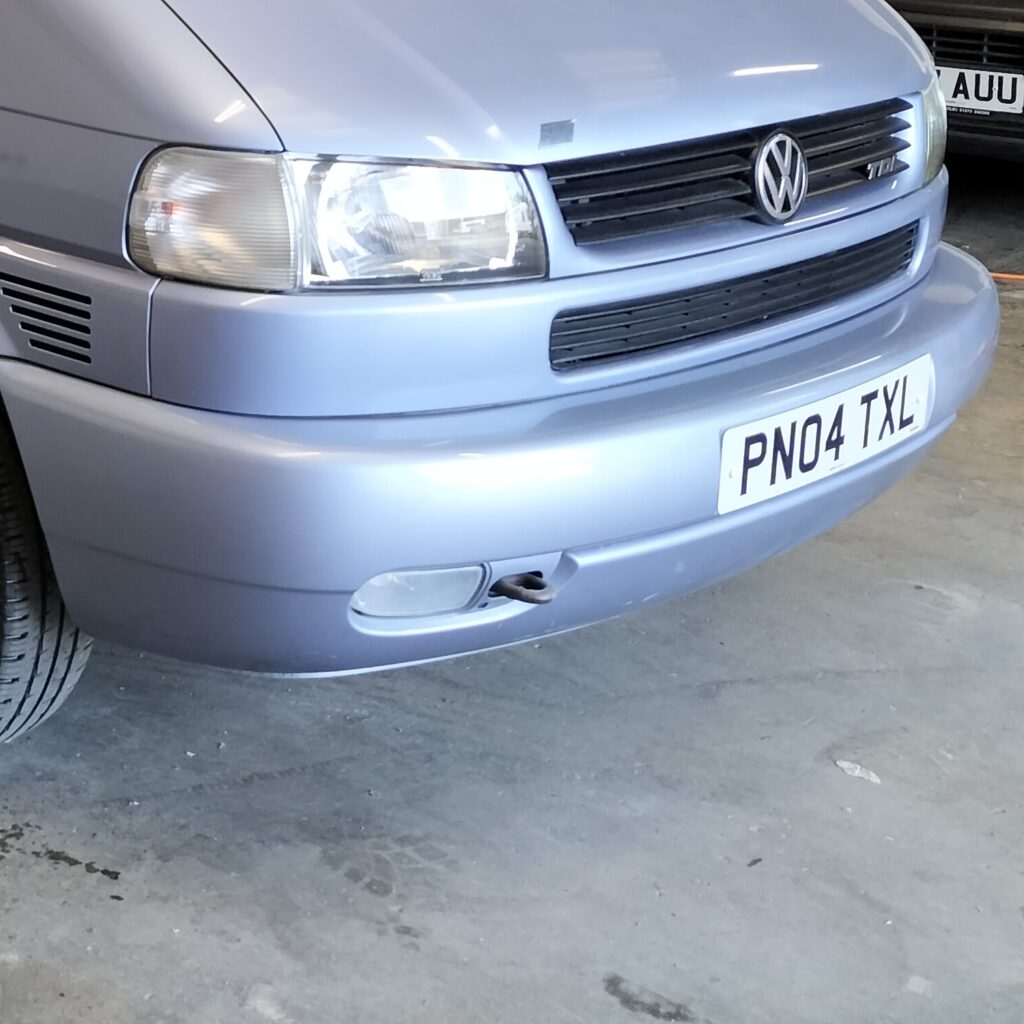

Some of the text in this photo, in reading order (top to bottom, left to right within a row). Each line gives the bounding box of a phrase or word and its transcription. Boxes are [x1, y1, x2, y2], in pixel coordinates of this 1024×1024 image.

[952, 71, 1018, 104] AUU
[758, 133, 805, 220] VW
[740, 375, 914, 496] PN04 TXL
